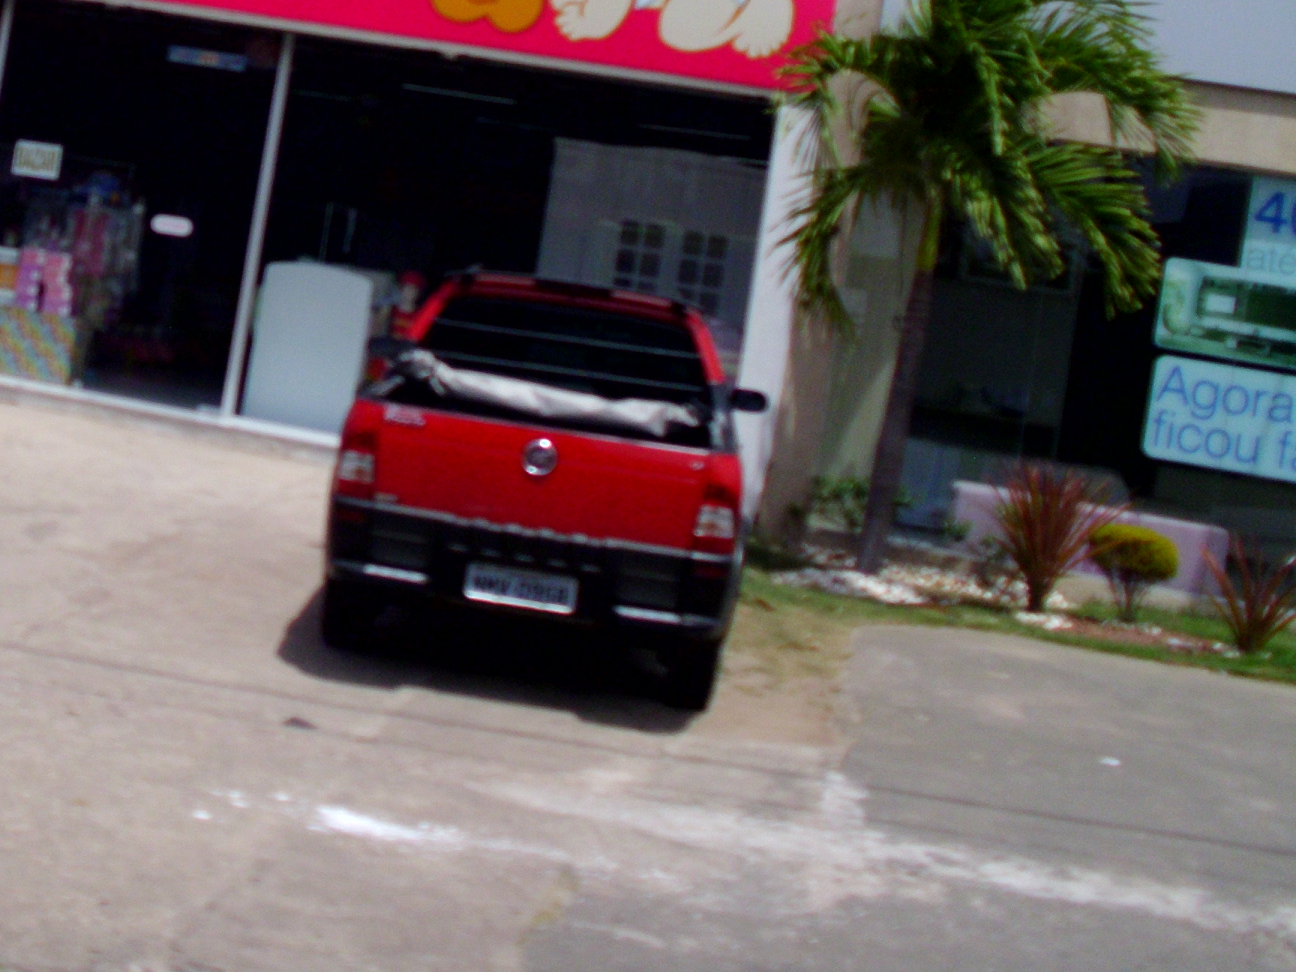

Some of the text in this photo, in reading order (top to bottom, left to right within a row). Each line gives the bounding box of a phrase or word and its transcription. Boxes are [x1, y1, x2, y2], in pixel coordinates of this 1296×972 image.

[1254, 192, 1296, 235] 4
[1156, 366, 1293, 424] Agora
[1153, 409, 1261, 465] ficou
